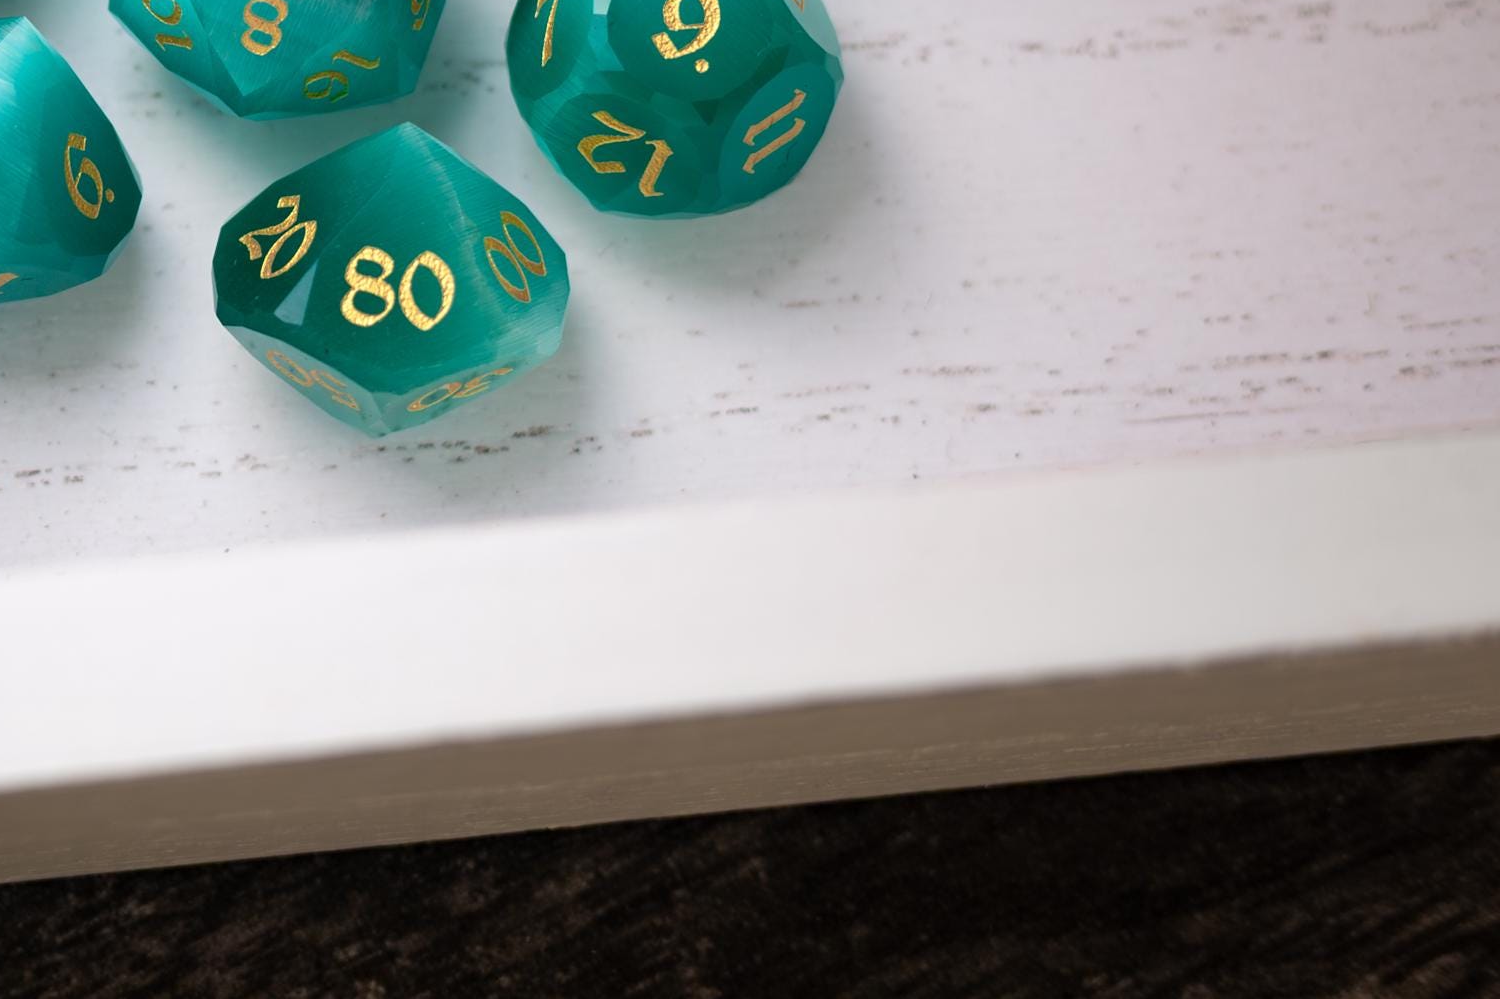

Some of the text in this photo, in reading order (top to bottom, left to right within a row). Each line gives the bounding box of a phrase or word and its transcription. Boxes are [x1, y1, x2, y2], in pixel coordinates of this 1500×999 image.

[577, 111, 674, 197] 12
[743, 88, 806, 174] 11
[238, 195, 318, 279] 20
[484, 211, 547, 304] 00
[340, 246, 455, 331] 80
